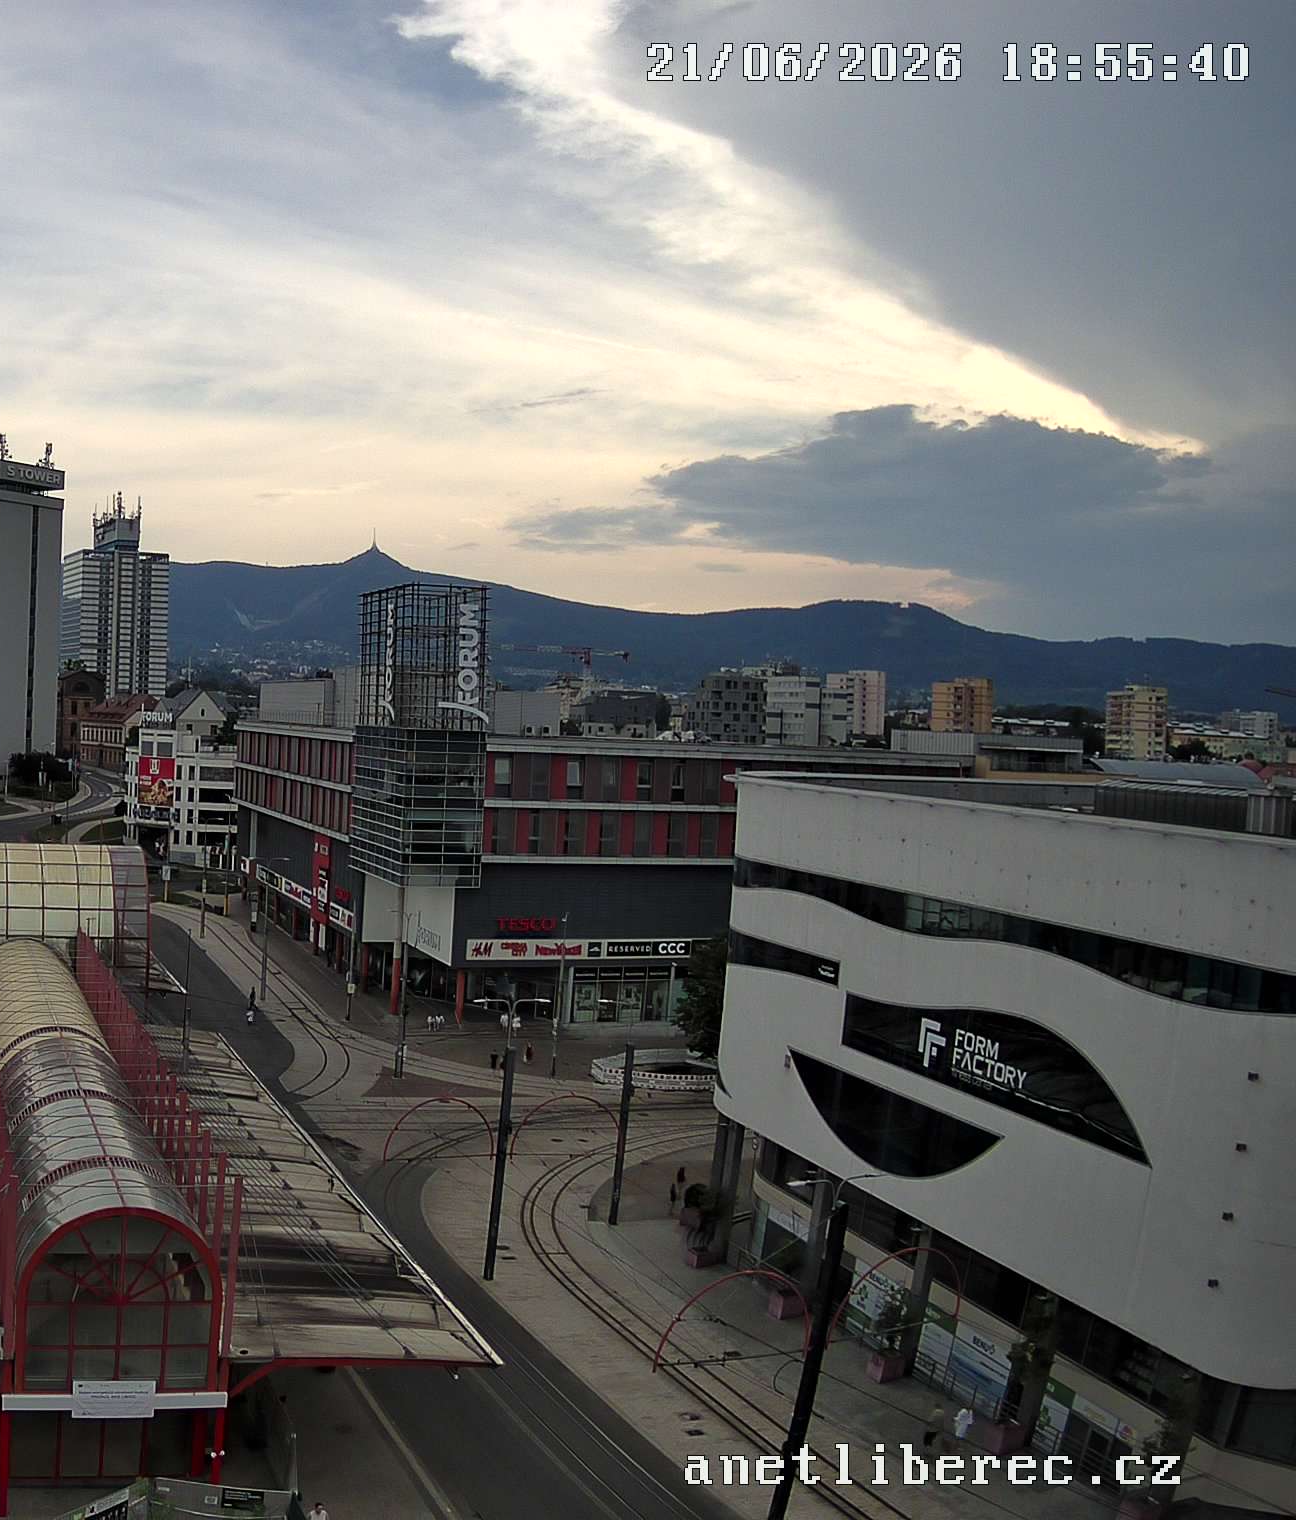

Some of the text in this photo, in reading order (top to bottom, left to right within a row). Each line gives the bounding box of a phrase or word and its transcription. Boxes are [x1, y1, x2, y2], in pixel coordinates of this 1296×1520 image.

[6, 465, 61, 485] S TOWER
[457, 603, 480, 706] FORUM
[143, 711, 173, 723] FORUM
[497, 915, 557, 931] TESCO
[608, 944, 651, 953] RESERVED
[658, 943, 685, 954] CCC
[954, 1028, 999, 1060] FORM
[952, 1047, 1027, 1089] FACTORY
